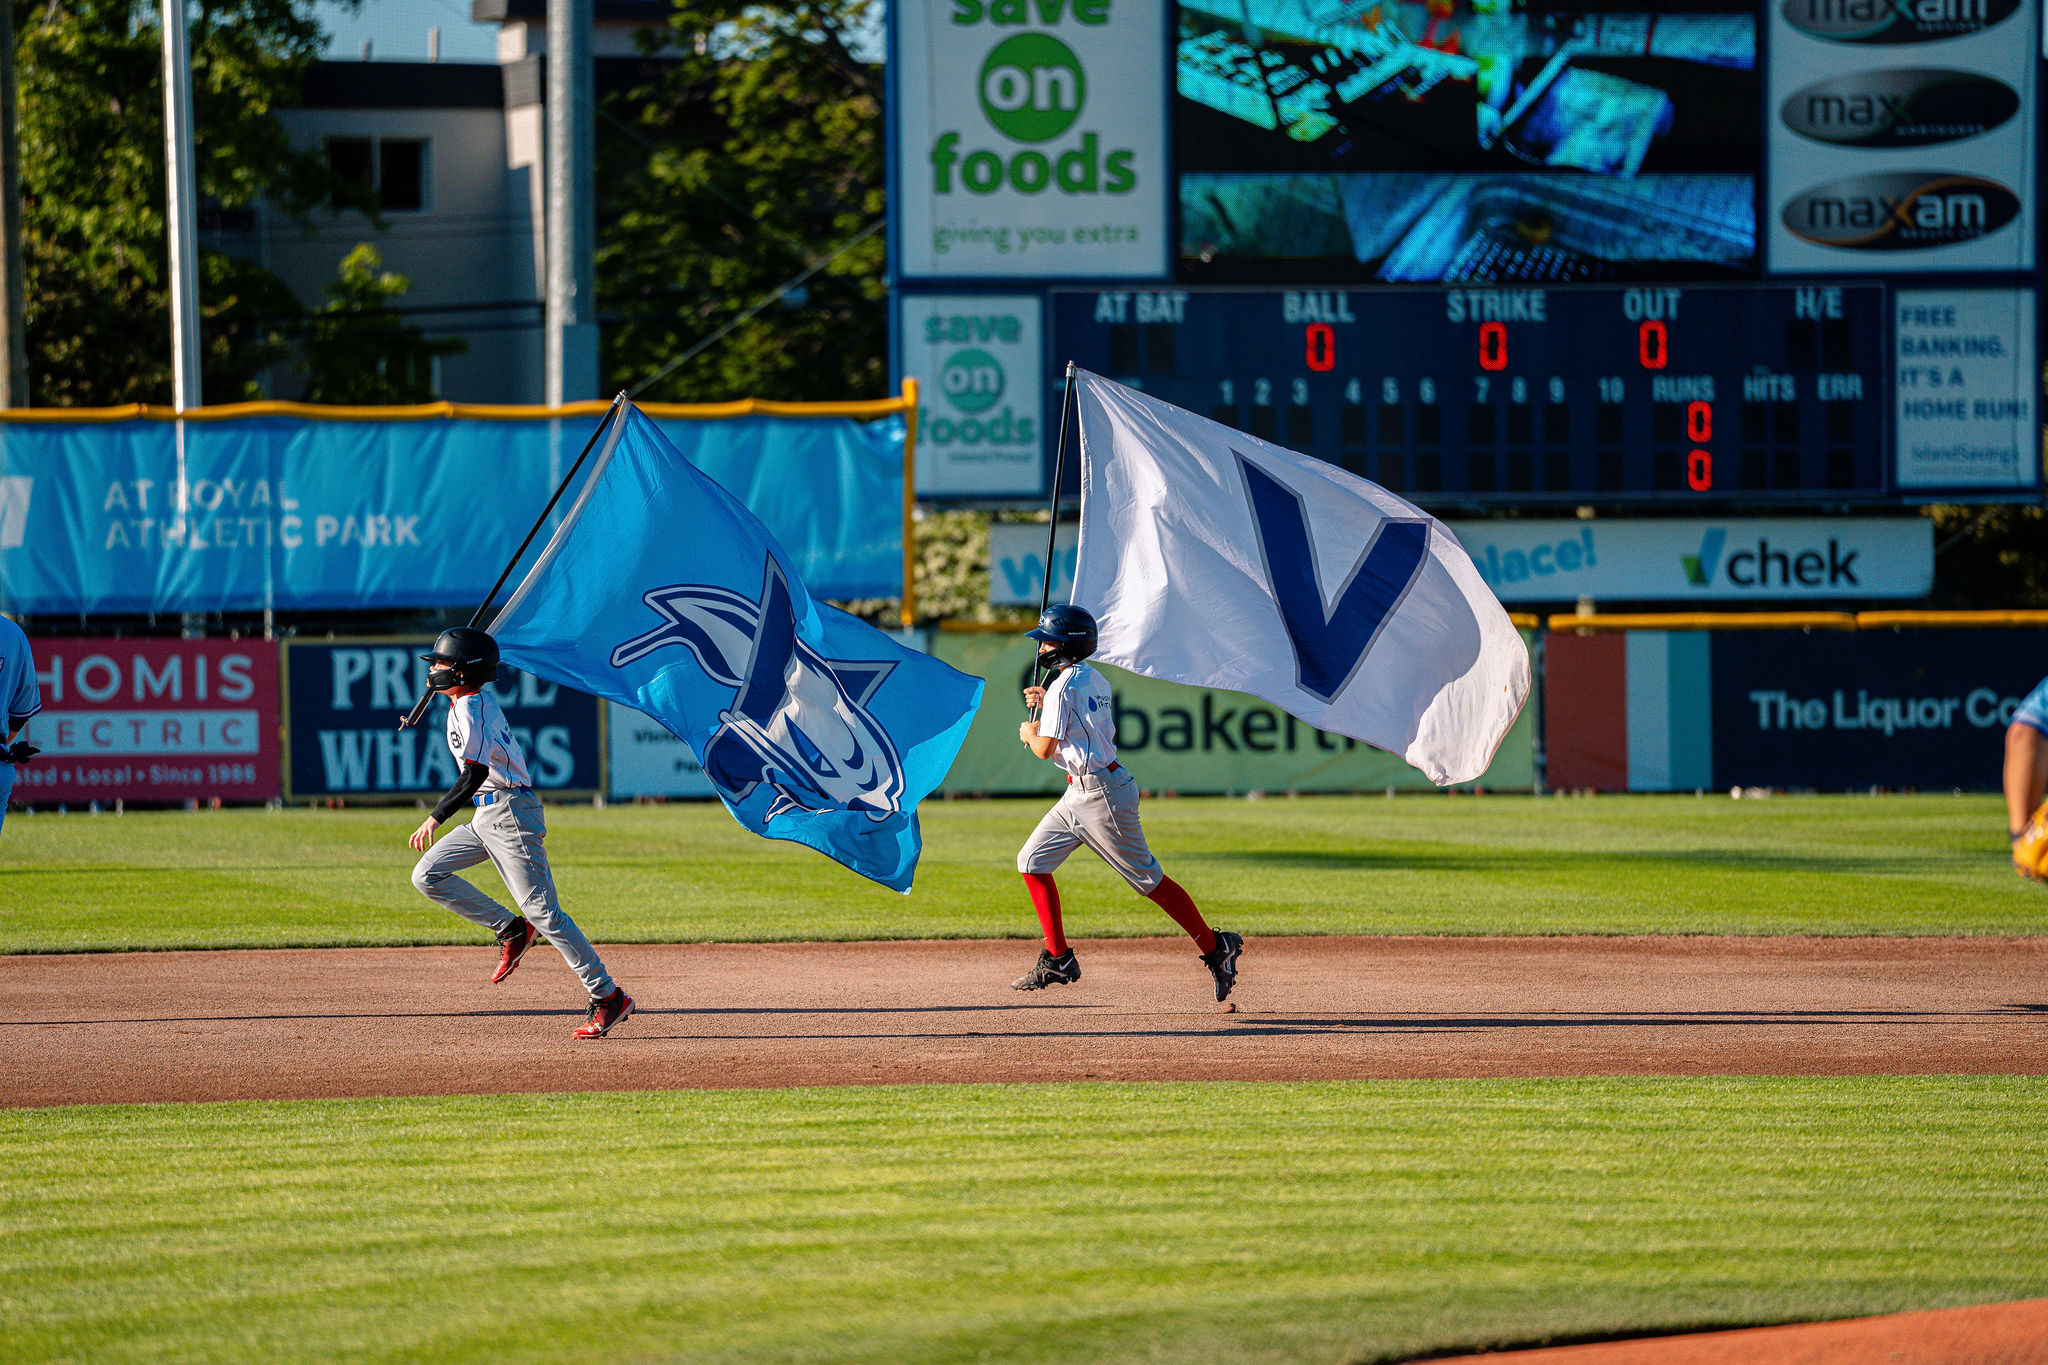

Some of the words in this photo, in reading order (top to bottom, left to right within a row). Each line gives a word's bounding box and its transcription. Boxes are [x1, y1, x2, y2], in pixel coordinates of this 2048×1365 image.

[952, 0, 1109, 25] save
[985, 65, 1077, 111] on
[930, 131, 1137, 194] foods
[933, 219, 1011, 253] giving
[1017, 226, 1065, 251] you
[1072, 223, 1139, 244] extra
[1095, 291, 1131, 323] AT
[1136, 291, 1188, 323] BAT
[1283, 291, 1355, 323] BALL
[1447, 289, 1547, 322] STRIKE
[1624, 288, 1682, 321] OUT
[1795, 287, 1843, 320] H/E
[1901, 305, 1956, 327] FREE
[924, 315, 1021, 344] save
[1479, 321, 1507, 371] 0
[1639, 320, 1667, 370] 0
[1305, 322, 1335, 372] 0
[946, 365, 998, 395] on
[1220, 377, 1234, 405] 1
[1255, 377, 1272, 405] 2
[1292, 377, 1309, 405] 3
[1345, 377, 1362, 405] 4
[1383, 377, 1400, 405] 5
[1419, 377, 1436, 405] 6
[1474, 376, 1491, 403] 7
[1512, 376, 1527, 403] 8
[1549, 376, 1565, 403] 9
[1599, 376, 1625, 402] 10
[1652, 375, 1715, 401] RUNS
[1744, 374, 1795, 401] HITS
[1817, 374, 1863, 400] ERR
[1949, 366, 1966, 388] A
[1688, 401, 1712, 443] 0
[1903, 399, 1967, 420] HOME
[1688, 449, 1712, 492] 0
[105, 479, 154, 512] AT
[169, 477, 299, 513] ROYAL
[106, 516, 304, 550] ATHLETIC
[315, 515, 421, 548] PARK
[1727, 538, 1860, 587] chek
[38, 655, 254, 702] HOMIS
[1749, 689, 1827, 730] The
[1833, 689, 1960, 737] Liquor
[1965, 687, 2018, 728] Co
[25, 719, 243, 747] LECTRIC
[76, 765, 131, 786] Local
[150, 764, 203, 786] Since
